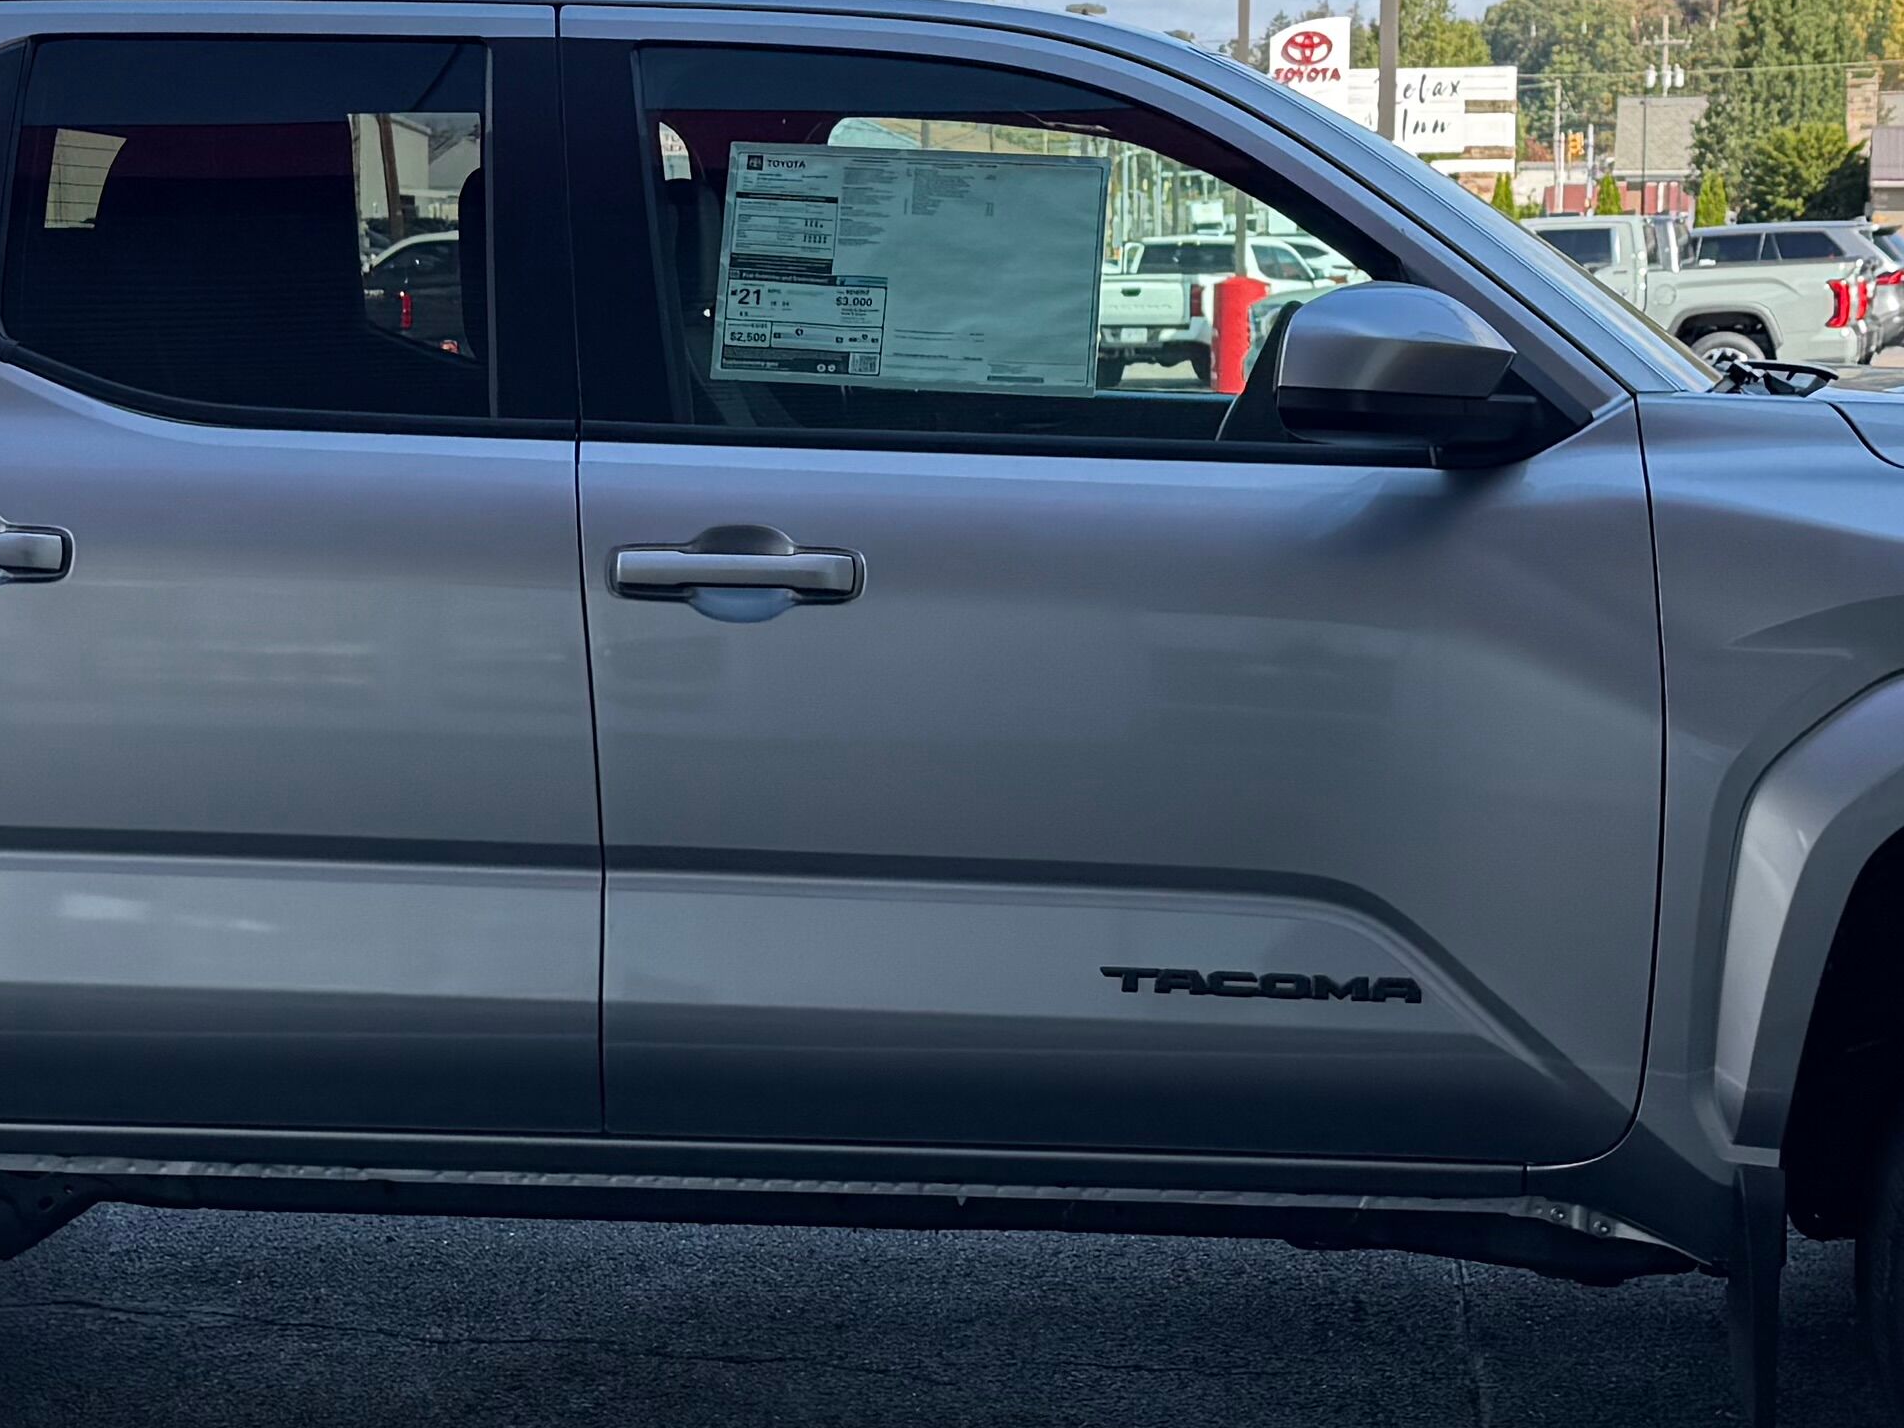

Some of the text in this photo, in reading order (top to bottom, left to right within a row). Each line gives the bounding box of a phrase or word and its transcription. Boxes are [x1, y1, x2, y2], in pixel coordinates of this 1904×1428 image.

[1273, 67, 1342, 84] TOYOTA
[1395, 73, 1462, 105] elax
[767, 159, 807, 170] TOYOTA
[737, 288, 762, 306] 21
[1099, 966, 1423, 1004] TACOMA
